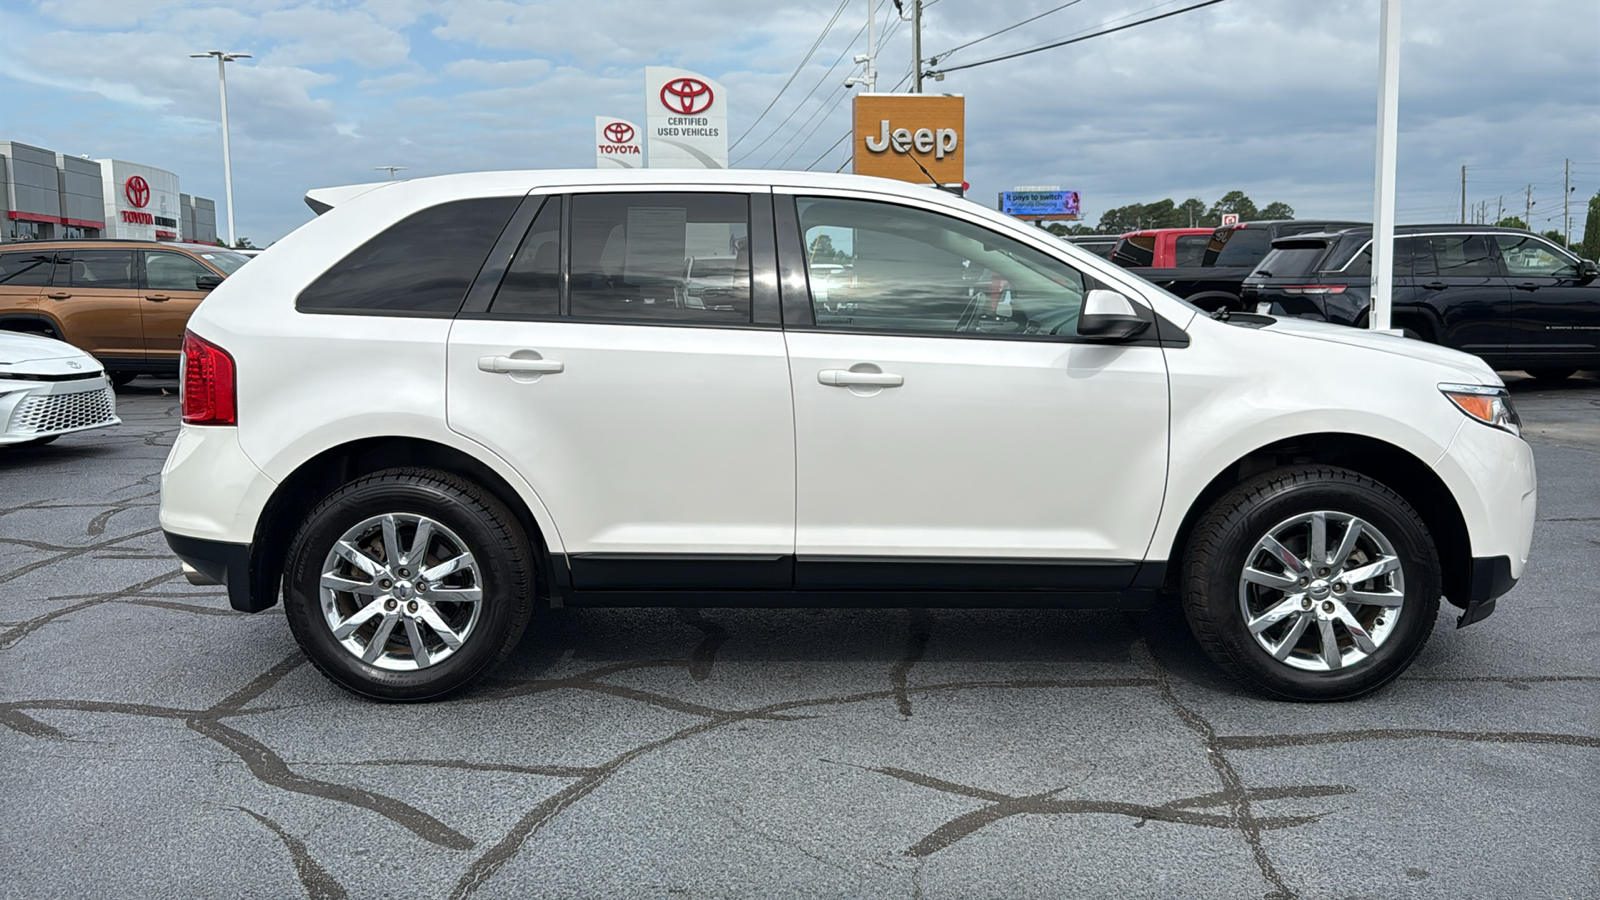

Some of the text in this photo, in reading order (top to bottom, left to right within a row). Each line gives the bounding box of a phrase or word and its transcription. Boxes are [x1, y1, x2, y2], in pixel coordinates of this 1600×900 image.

[667, 117, 708, 126] CERTIFIED
[657, 127, 719, 137] USED VEHICLES
[865, 119, 958, 160] Jeep
[598, 145, 641, 155] TOYOTA
[1012, 194, 1030, 202] pays
[121, 210, 154, 225] TOYOTA
